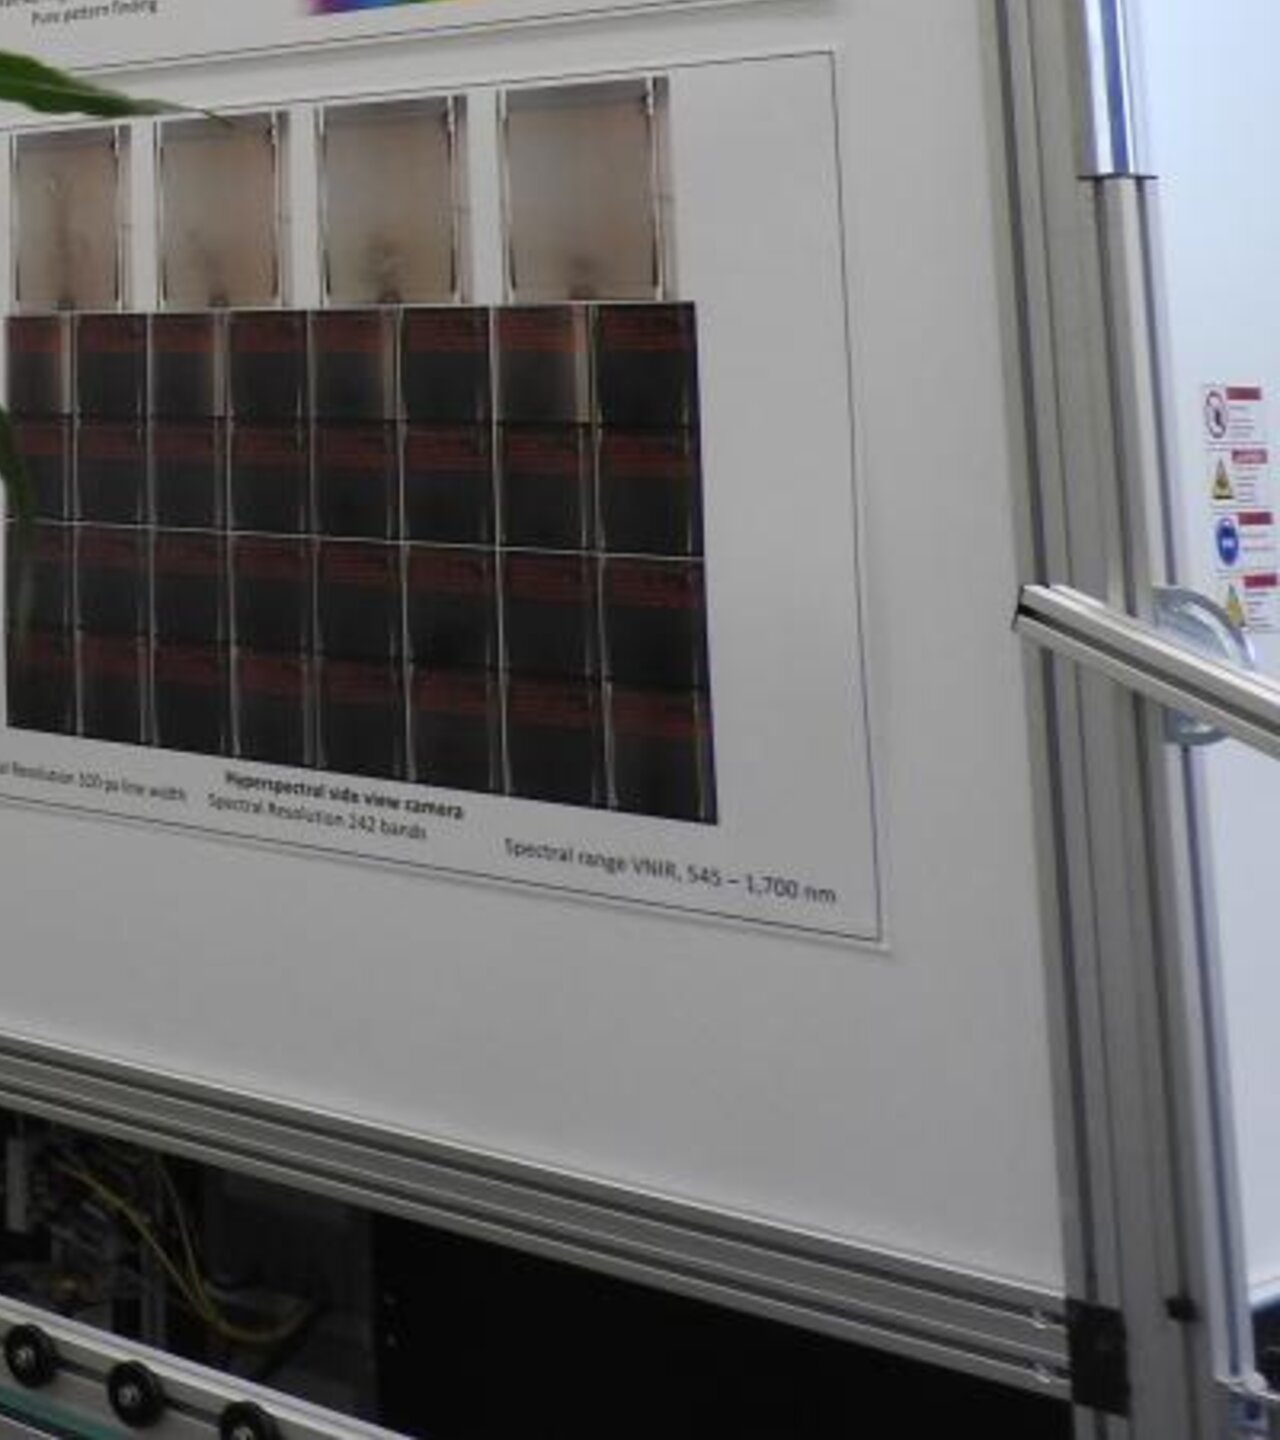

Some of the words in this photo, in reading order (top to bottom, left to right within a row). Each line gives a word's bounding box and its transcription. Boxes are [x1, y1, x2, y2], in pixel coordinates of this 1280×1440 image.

[207, 792, 264, 816] Spectral
[267, 801, 344, 826] Resolution
[347, 812, 376, 834] 242
[379, 816, 428, 841] bands
[224, 770, 325, 799] Hyperspectral
[328, 786, 360, 806] side
[363, 792, 401, 811] view
[404, 798, 465, 822] camera
[503, 837, 575, 866] Spectral
[578, 849, 628, 875] range
[687, 860, 722, 888] 545
[803, 884, 838, 905] nm
